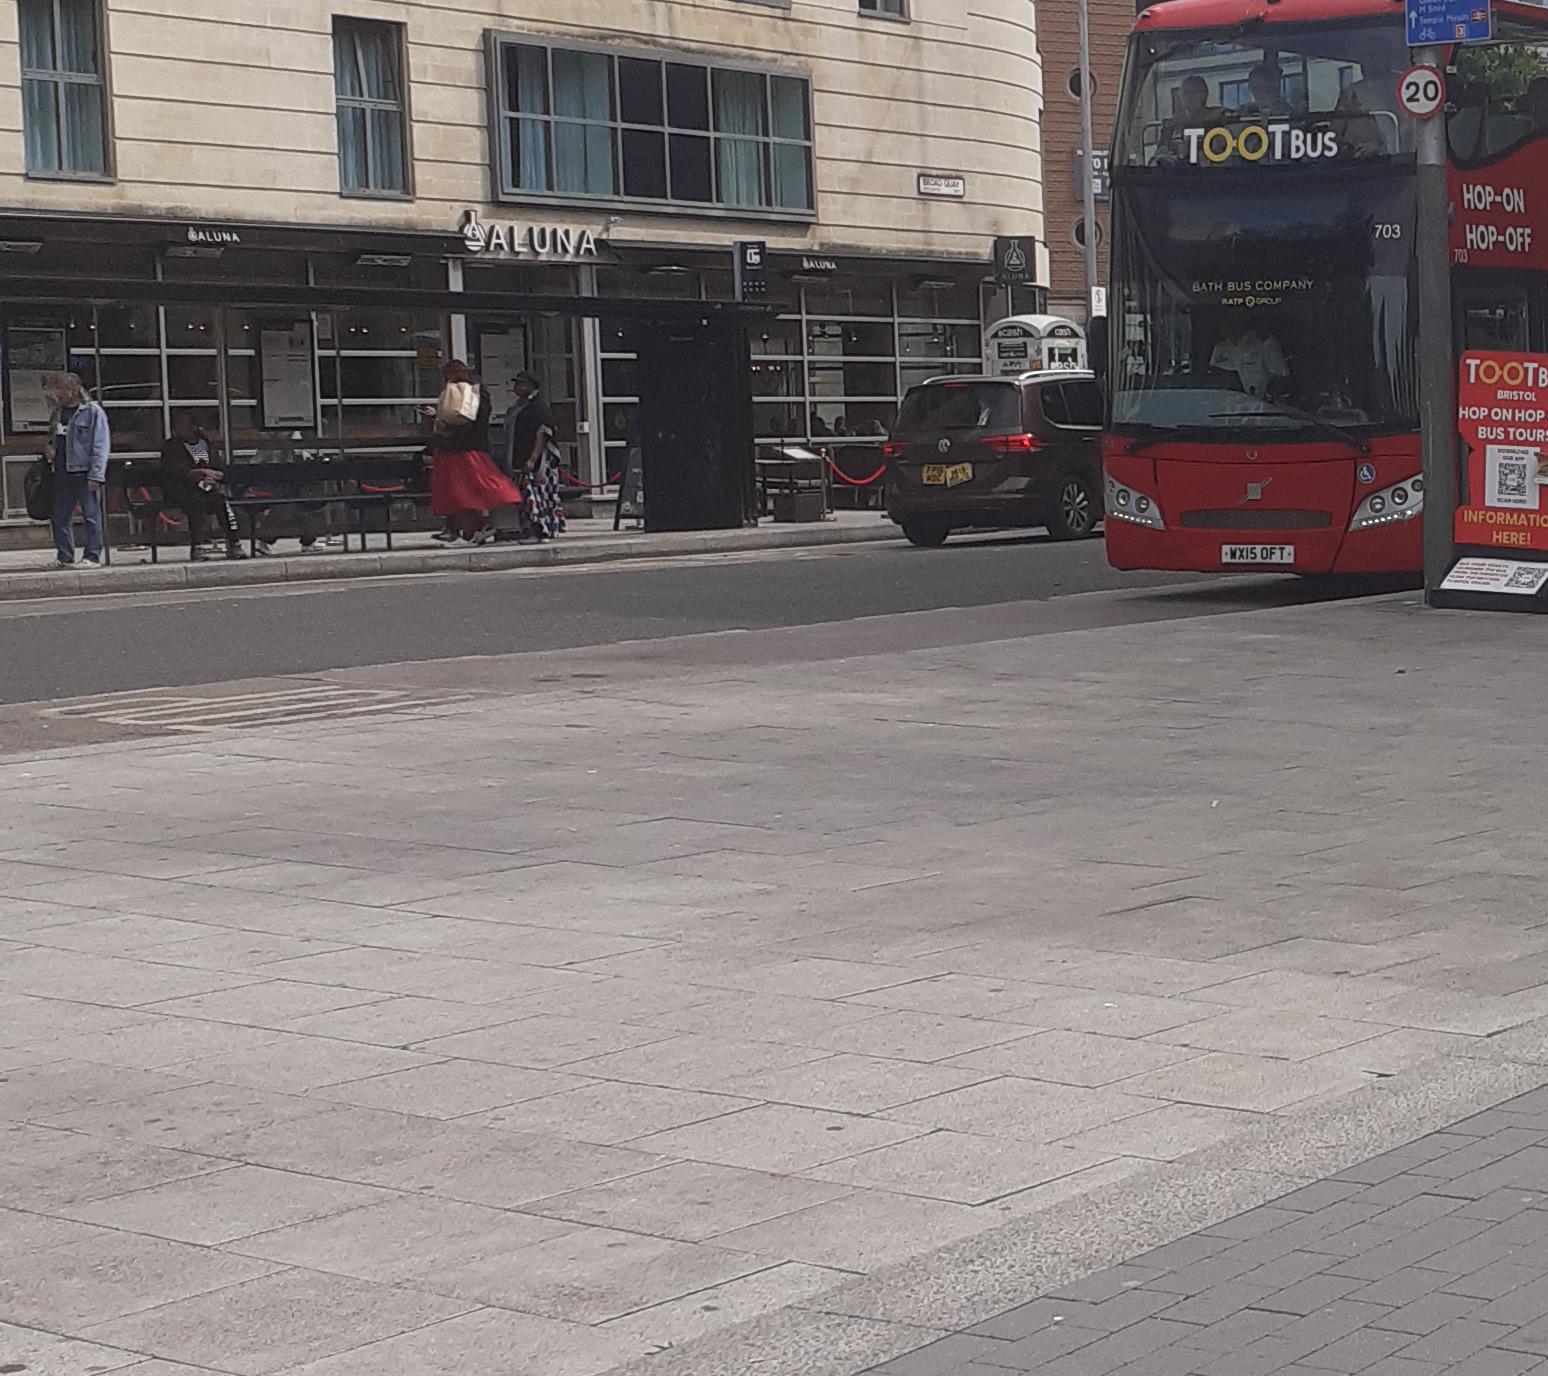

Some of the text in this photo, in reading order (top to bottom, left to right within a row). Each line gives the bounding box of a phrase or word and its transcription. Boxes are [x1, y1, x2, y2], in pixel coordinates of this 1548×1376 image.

[1405, 80, 1439, 103] 20
[1462, 183, 1526, 213] HOP-ON
[198, 231, 240, 242] ALUNA
[1374, 224, 1401, 238] 703
[1465, 224, 1532, 252] HOP-OFF
[487, 224, 598, 256] ALUNA
[1454, 249, 1468, 263] 703
[1192, 280, 1314, 292] BATH BUS COMPANY
[1496, 390, 1537, 402] BRISTOL
[1459, 406, 1489, 420] HOP
[1491, 408, 1513, 421] ON
[1515, 409, 1545, 423] HOP
[1478, 426, 1505, 440] BUS
[1492, 531, 1531, 545] HERE!
[1229, 547, 1286, 561] WX15 OFT
